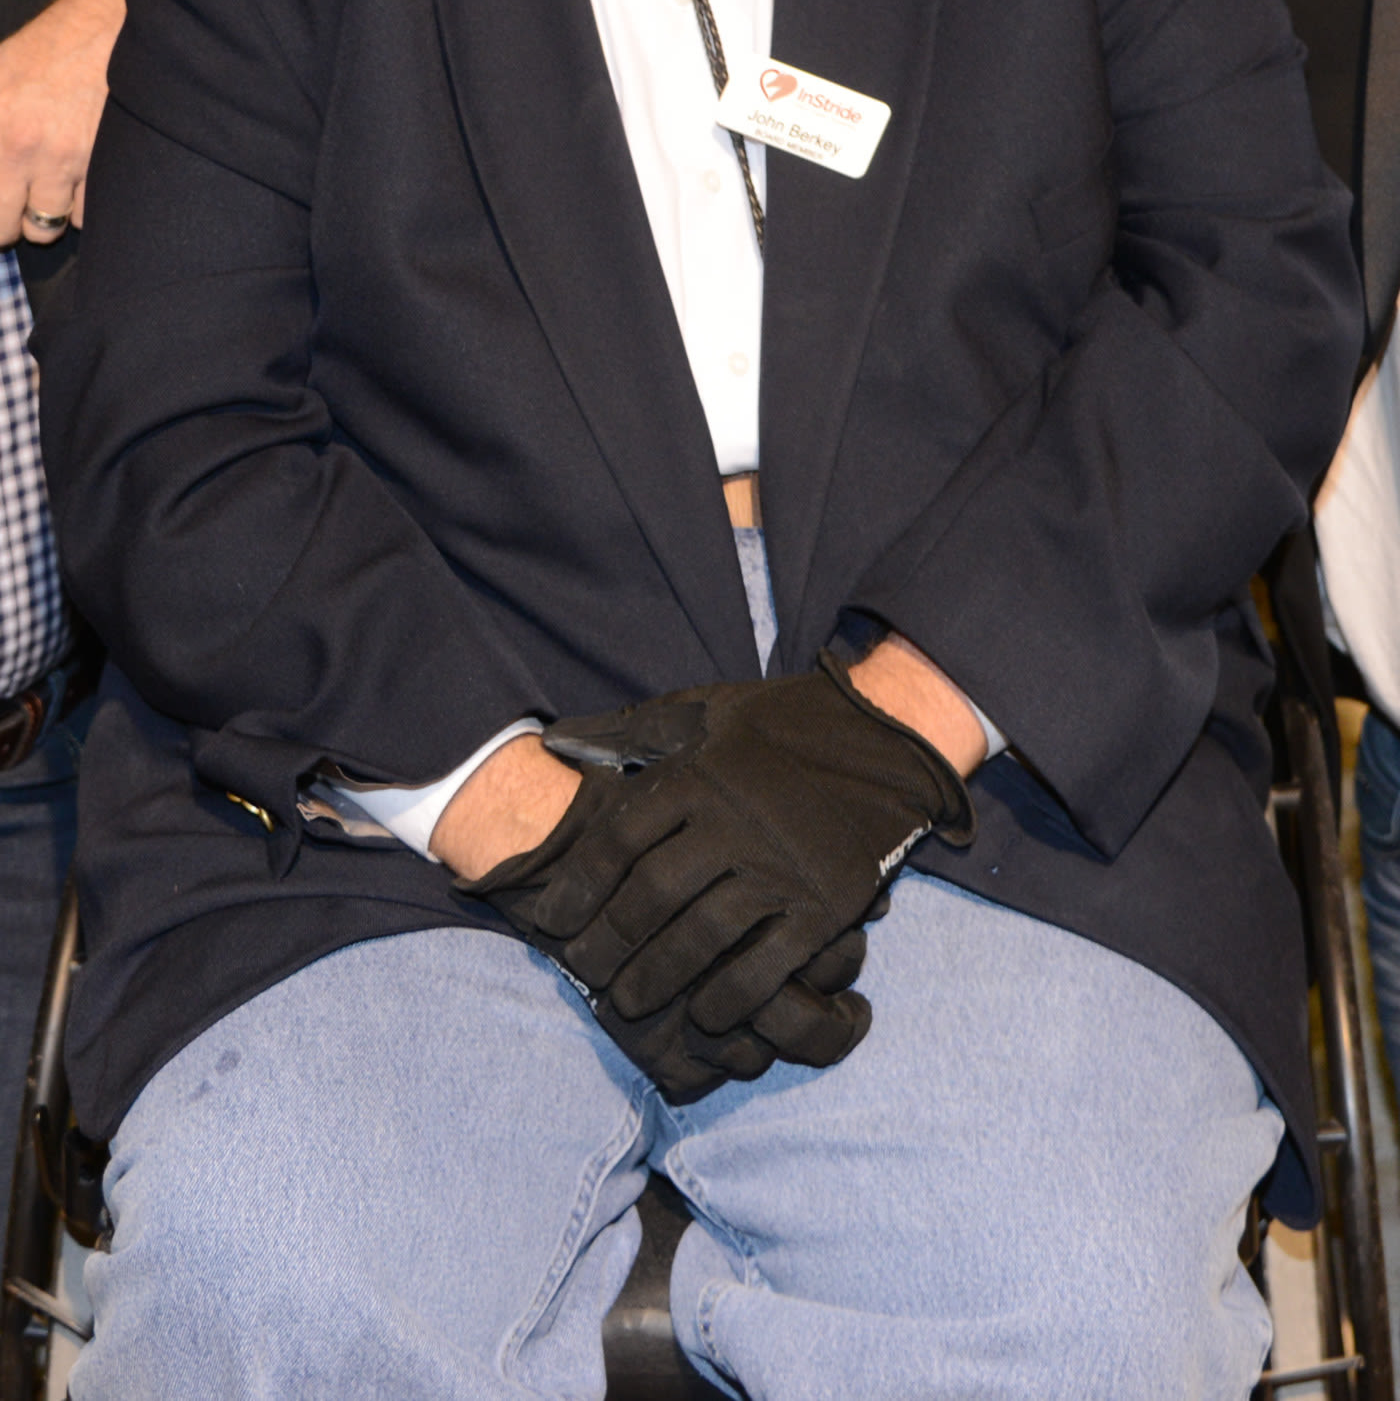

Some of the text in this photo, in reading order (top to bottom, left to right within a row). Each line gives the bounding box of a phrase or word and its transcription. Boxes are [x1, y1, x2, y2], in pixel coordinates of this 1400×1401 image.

[796, 87, 863, 124] InStride
[747, 109, 785, 132] John
[788, 124, 843, 158] Berkey
